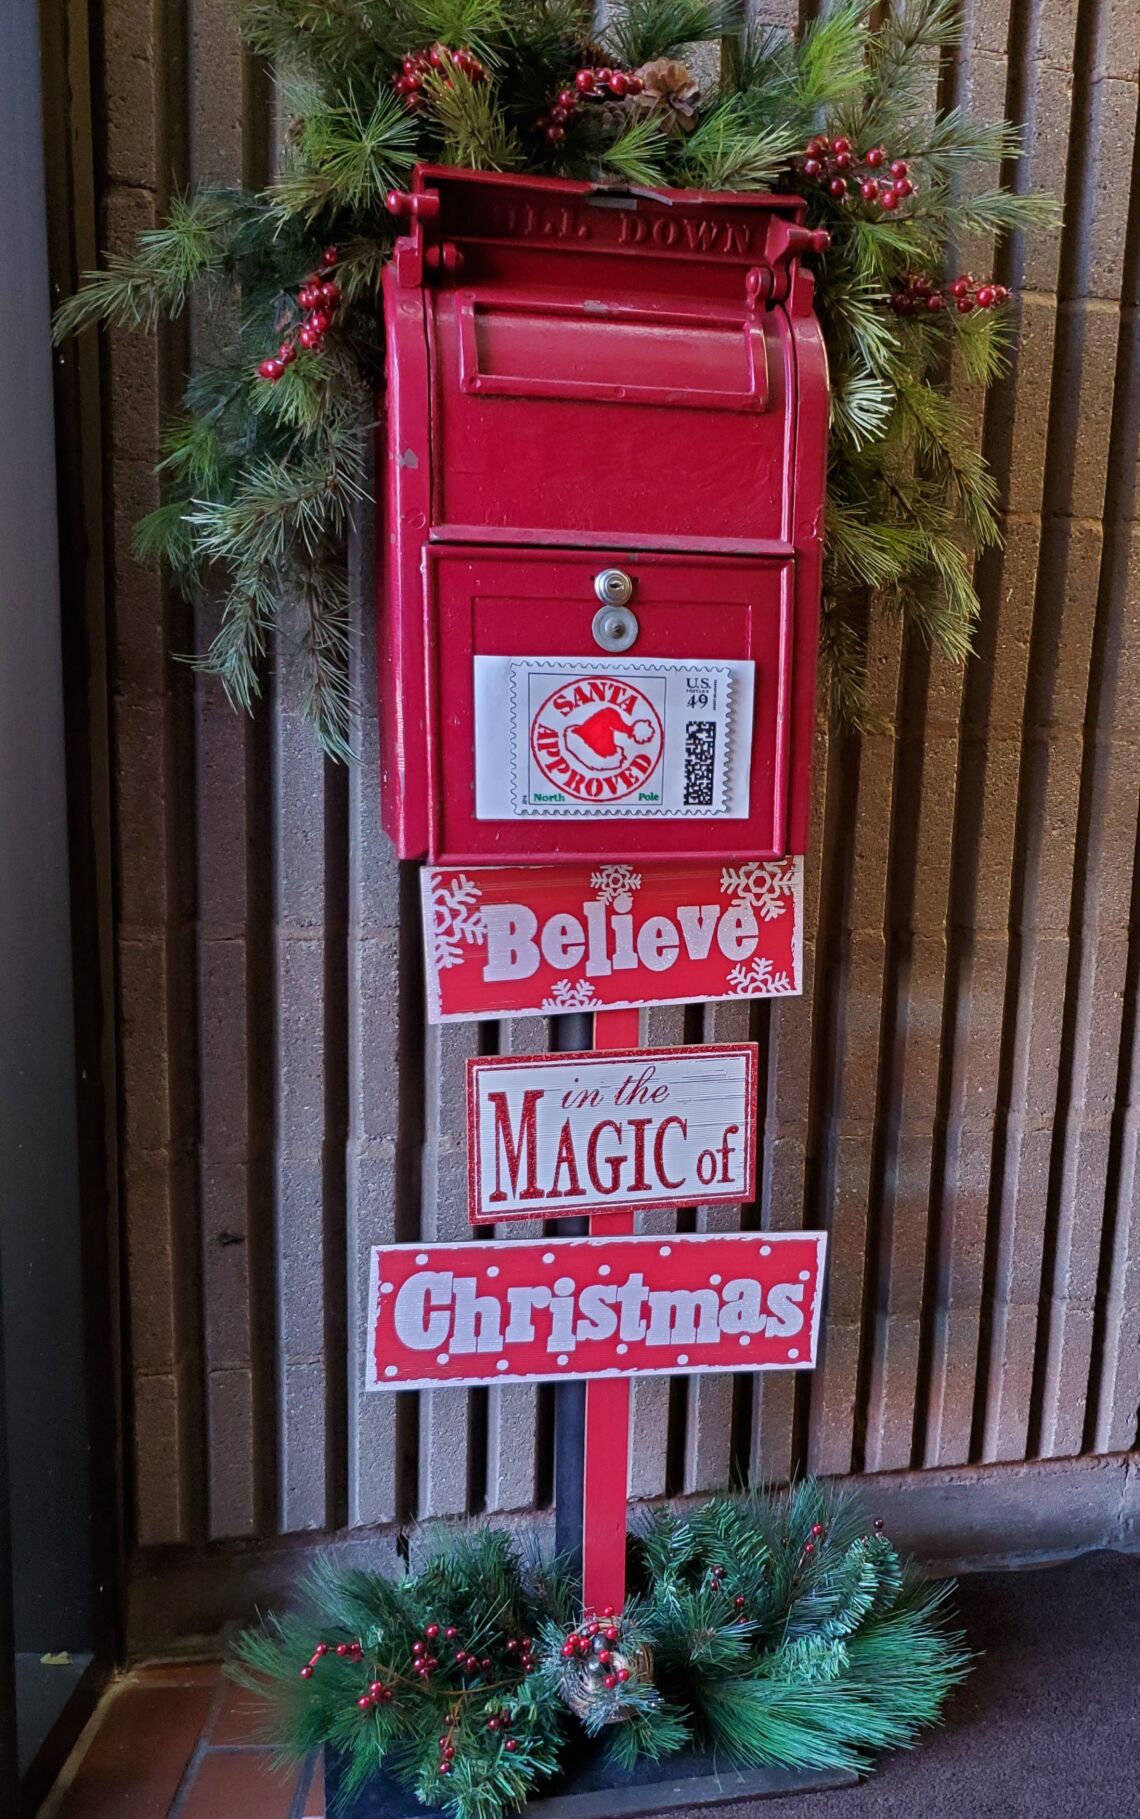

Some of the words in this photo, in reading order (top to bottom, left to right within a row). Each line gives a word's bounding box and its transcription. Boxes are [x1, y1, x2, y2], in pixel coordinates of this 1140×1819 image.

[618, 211, 753, 253] DOWN
[552, 681, 639, 717] SANTA
[686, 677, 711, 689] U.S.
[686, 693, 709, 709] 49
[537, 723, 652, 797] APPROVED
[533, 792, 566, 802] North
[637, 792, 660, 801] Pole
[480, 893, 759, 983] Believe
[561, 1077, 603, 1110] in
[612, 1065, 671, 1106] the
[488, 1089, 689, 1203] MAGIC
[696, 1124, 740, 1186] of
[394, 1270, 805, 1354] Christmas
